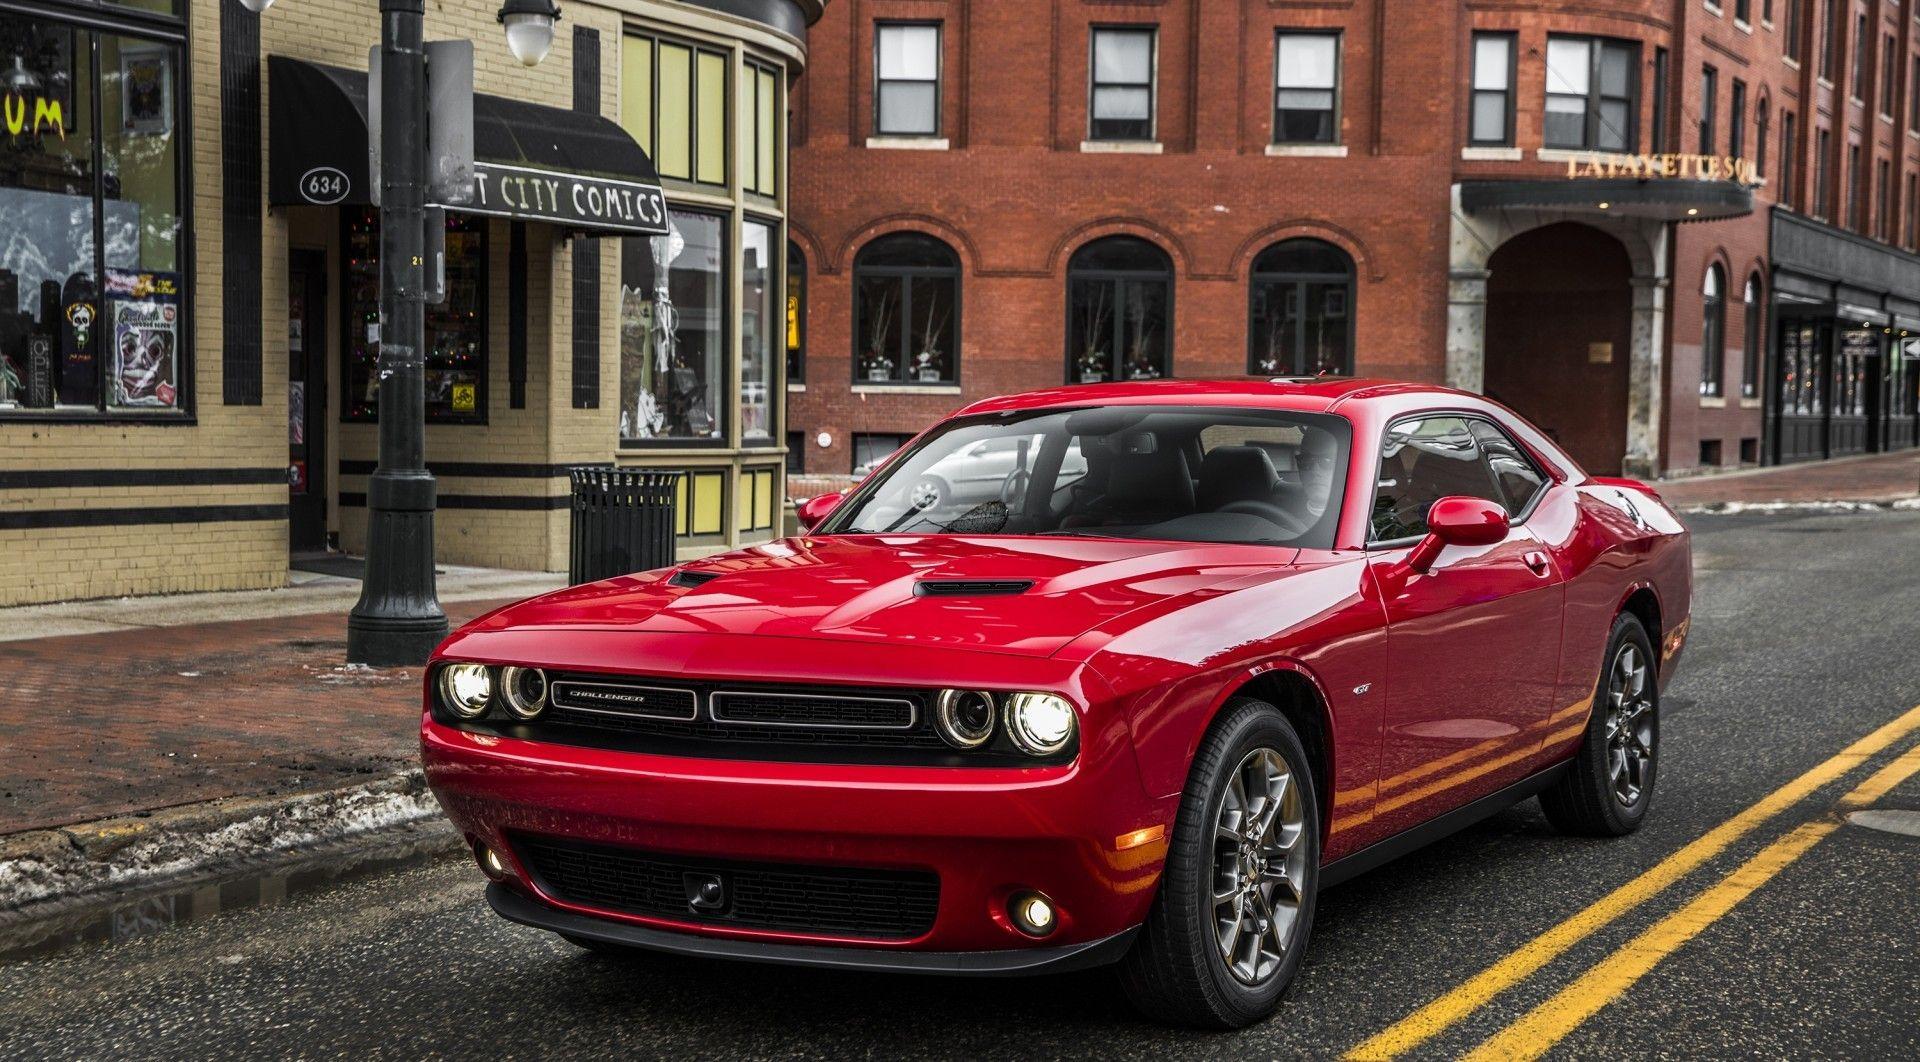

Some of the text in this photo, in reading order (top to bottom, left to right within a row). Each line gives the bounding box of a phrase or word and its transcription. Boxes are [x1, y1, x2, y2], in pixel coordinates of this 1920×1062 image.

[1567, 153, 1720, 180] LAFAYETTE
[310, 176, 341, 194] 634
[501, 176, 559, 212] CITY
[572, 183, 662, 224] COMICS
[570, 690, 645, 702] CHALLENGER
